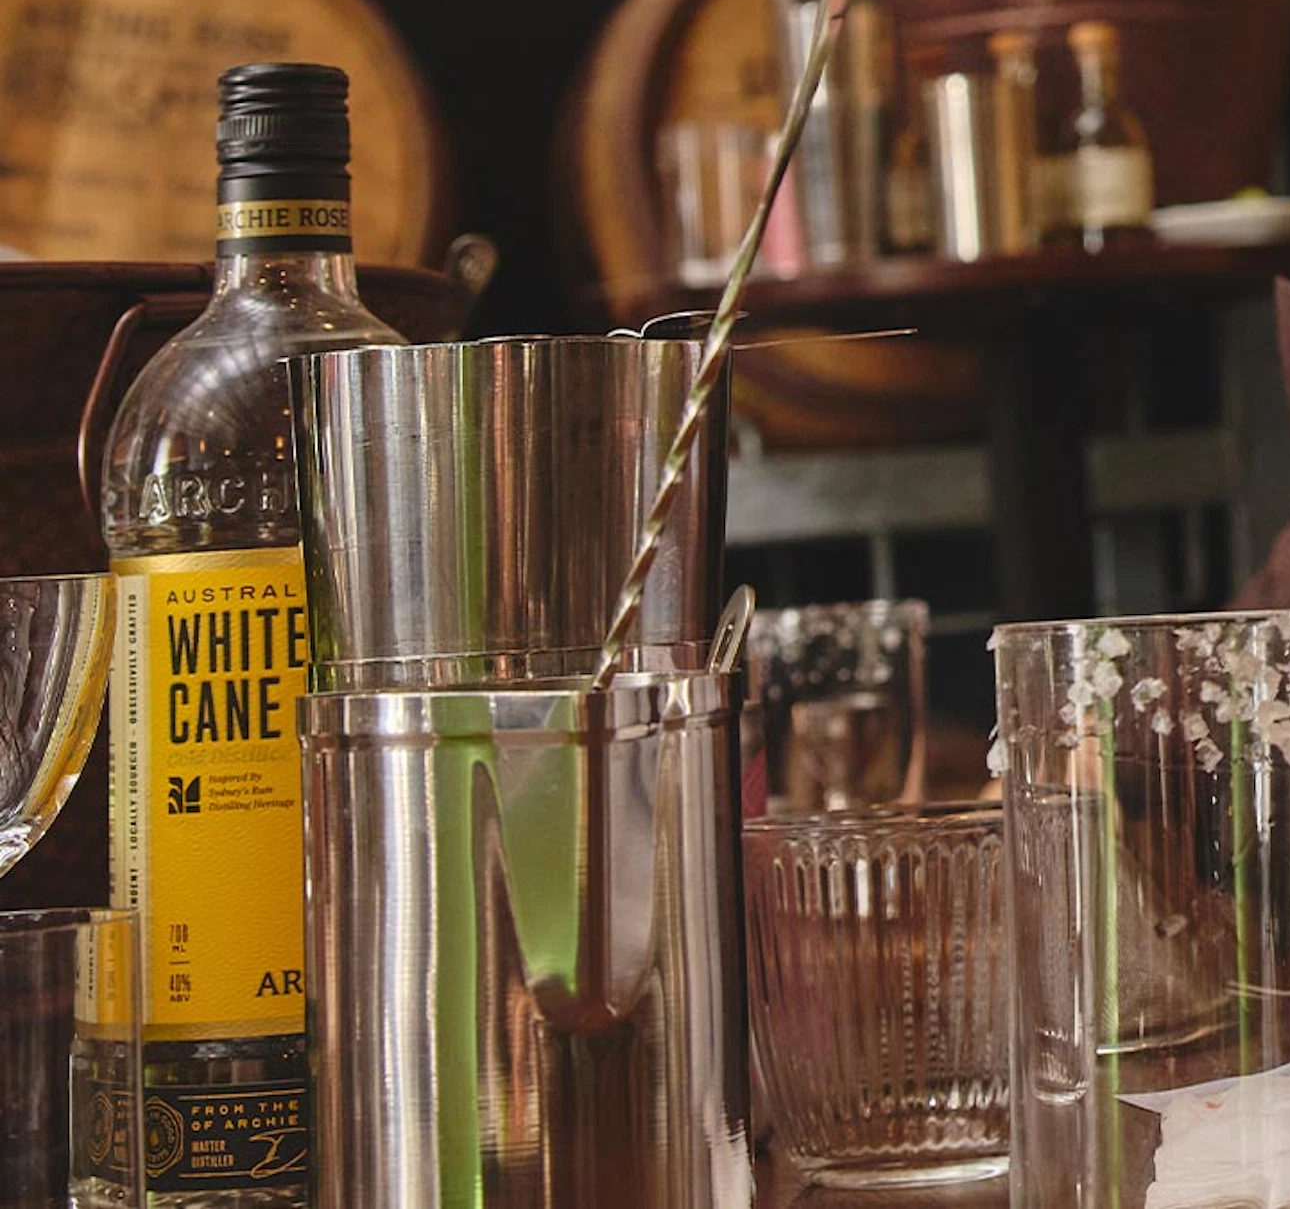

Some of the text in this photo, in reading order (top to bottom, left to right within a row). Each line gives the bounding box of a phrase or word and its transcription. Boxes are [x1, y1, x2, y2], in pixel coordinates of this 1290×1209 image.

[300, 207, 349, 228] ROSE
[128, 594, 138, 644] CRAFTED
[167, 606, 305, 675] WHITE
[128, 650, 138, 724] OBSESSIVELY
[169, 676, 281, 744] CANE
[129, 741, 138, 794] SOURCED
[129, 800, 138, 850] LOCALLY
[190, 1099, 299, 1116] FROM THE
[190, 1114, 299, 1132] OF ARCHIE
